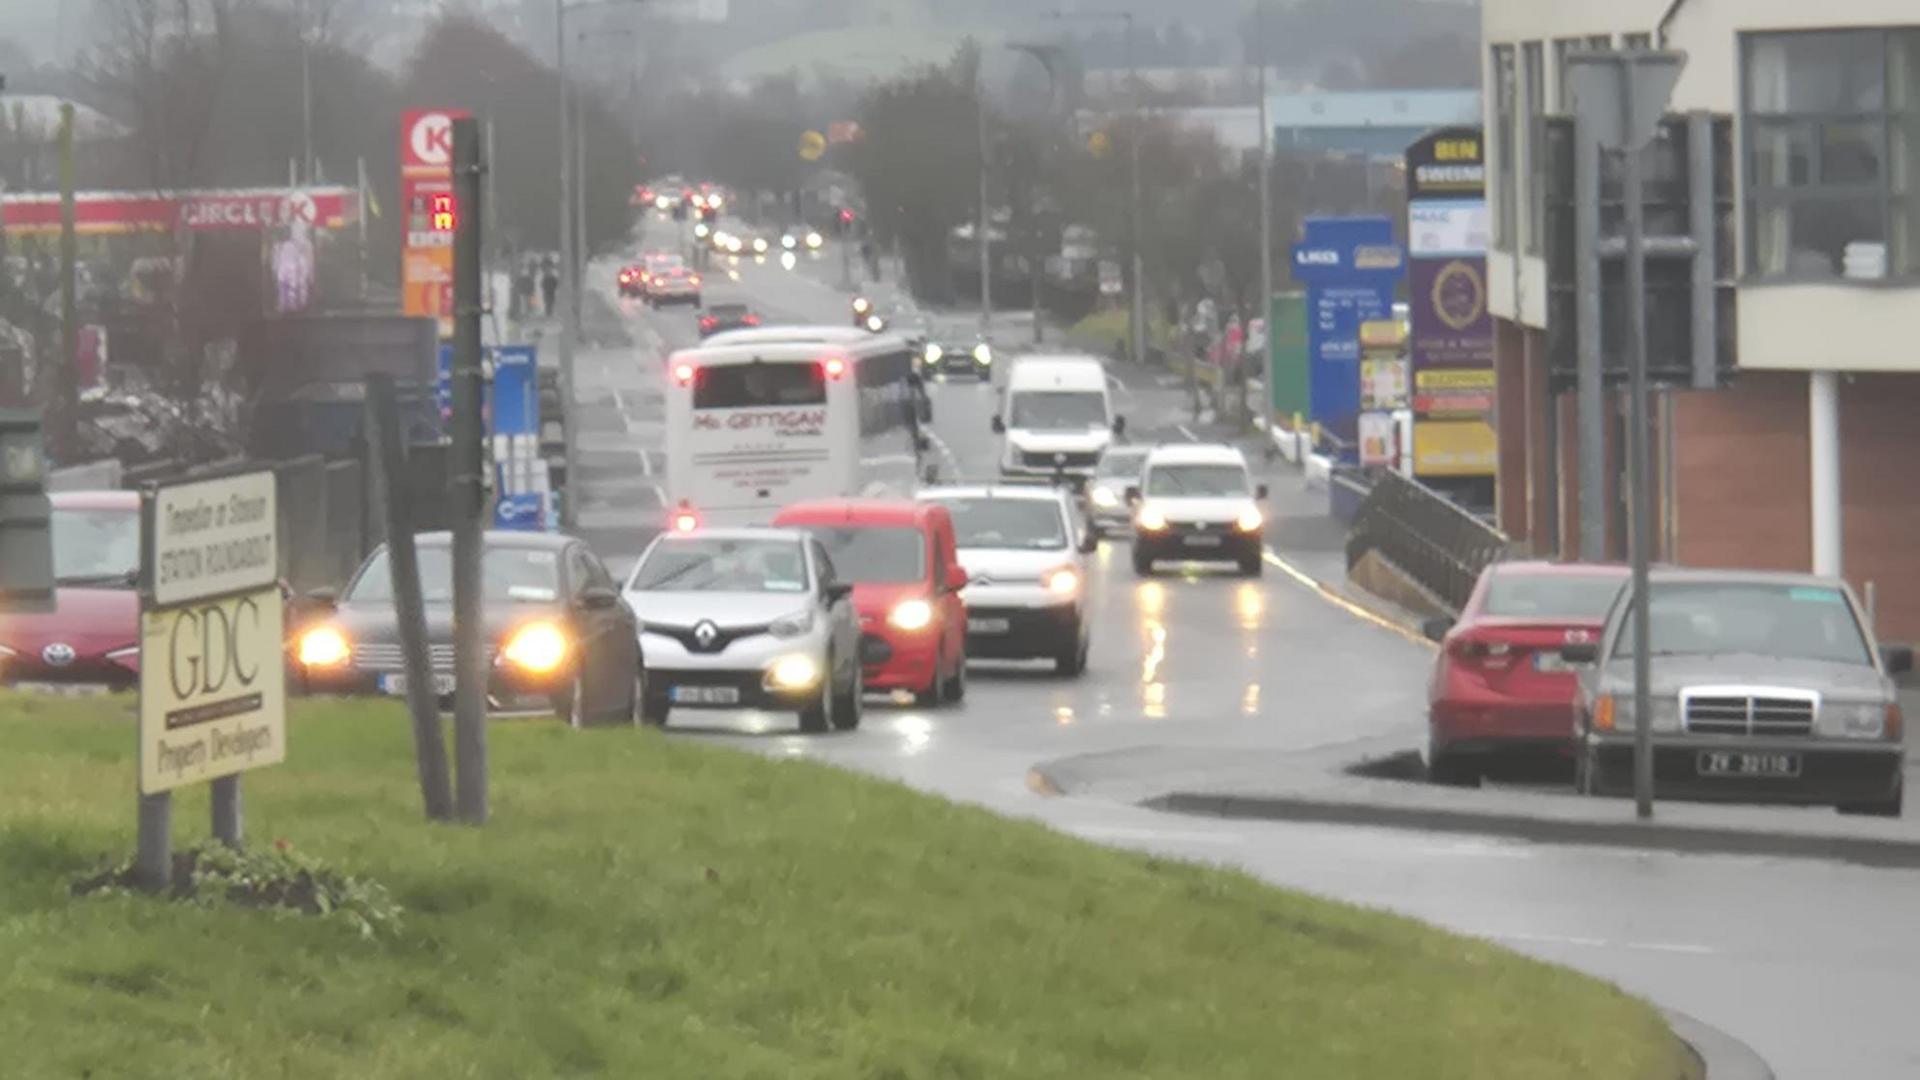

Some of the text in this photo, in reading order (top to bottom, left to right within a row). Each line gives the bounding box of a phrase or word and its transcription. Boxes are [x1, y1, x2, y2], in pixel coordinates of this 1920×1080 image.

[1433, 139, 1479, 162] BEN
[160, 533, 272, 585] STATION ROUNDABOUT
[169, 596, 260, 701] GDC
[157, 722, 273, 780] Property Developers
